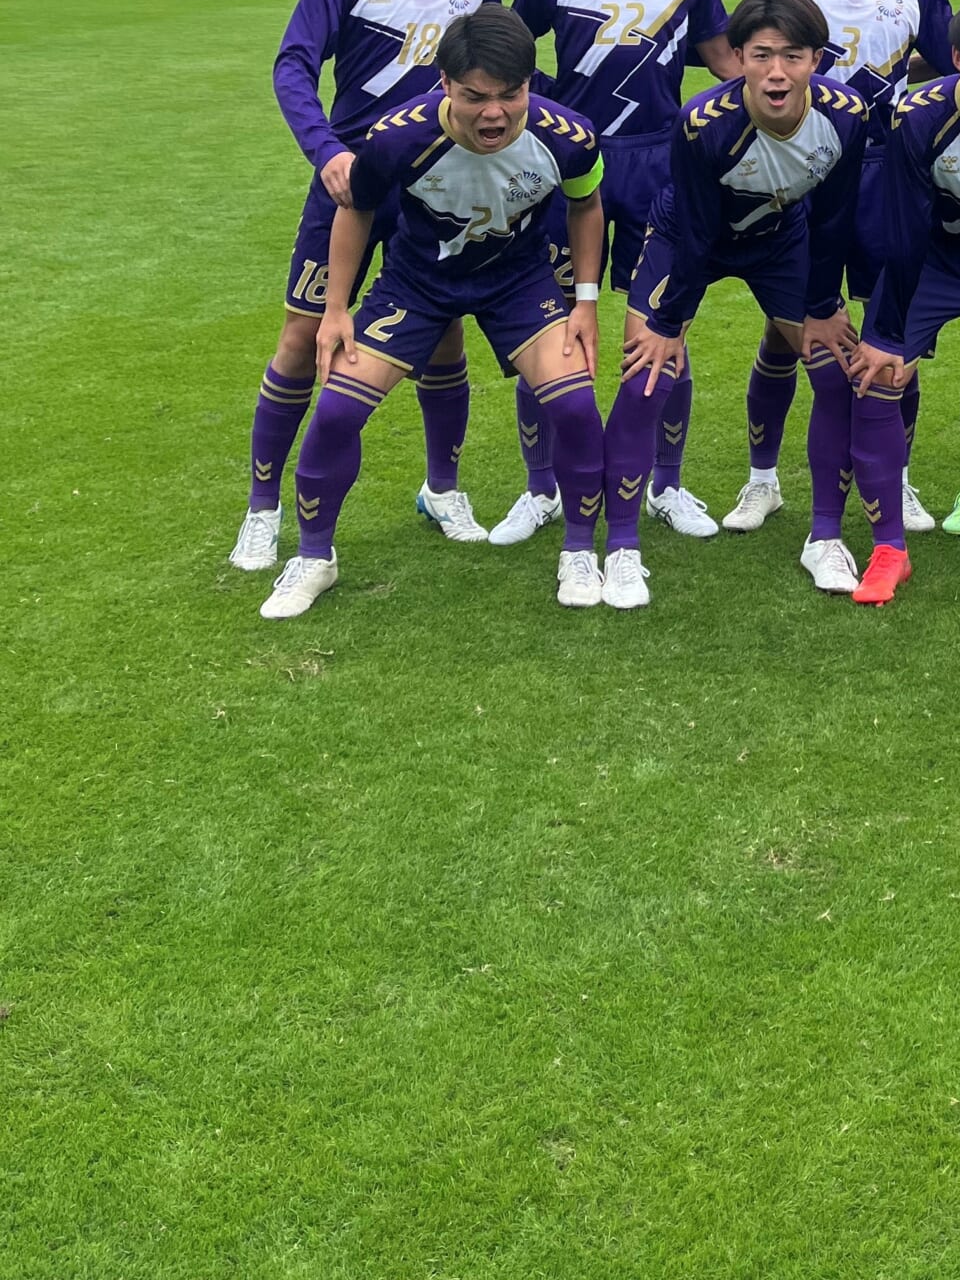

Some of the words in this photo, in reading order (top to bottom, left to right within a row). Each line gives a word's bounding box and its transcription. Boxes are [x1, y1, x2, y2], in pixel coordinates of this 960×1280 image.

[397, 22, 441, 65] 18
[594, 2, 645, 45] 22
[835, 26, 861, 67] 3
[464, 205, 493, 241] 2
